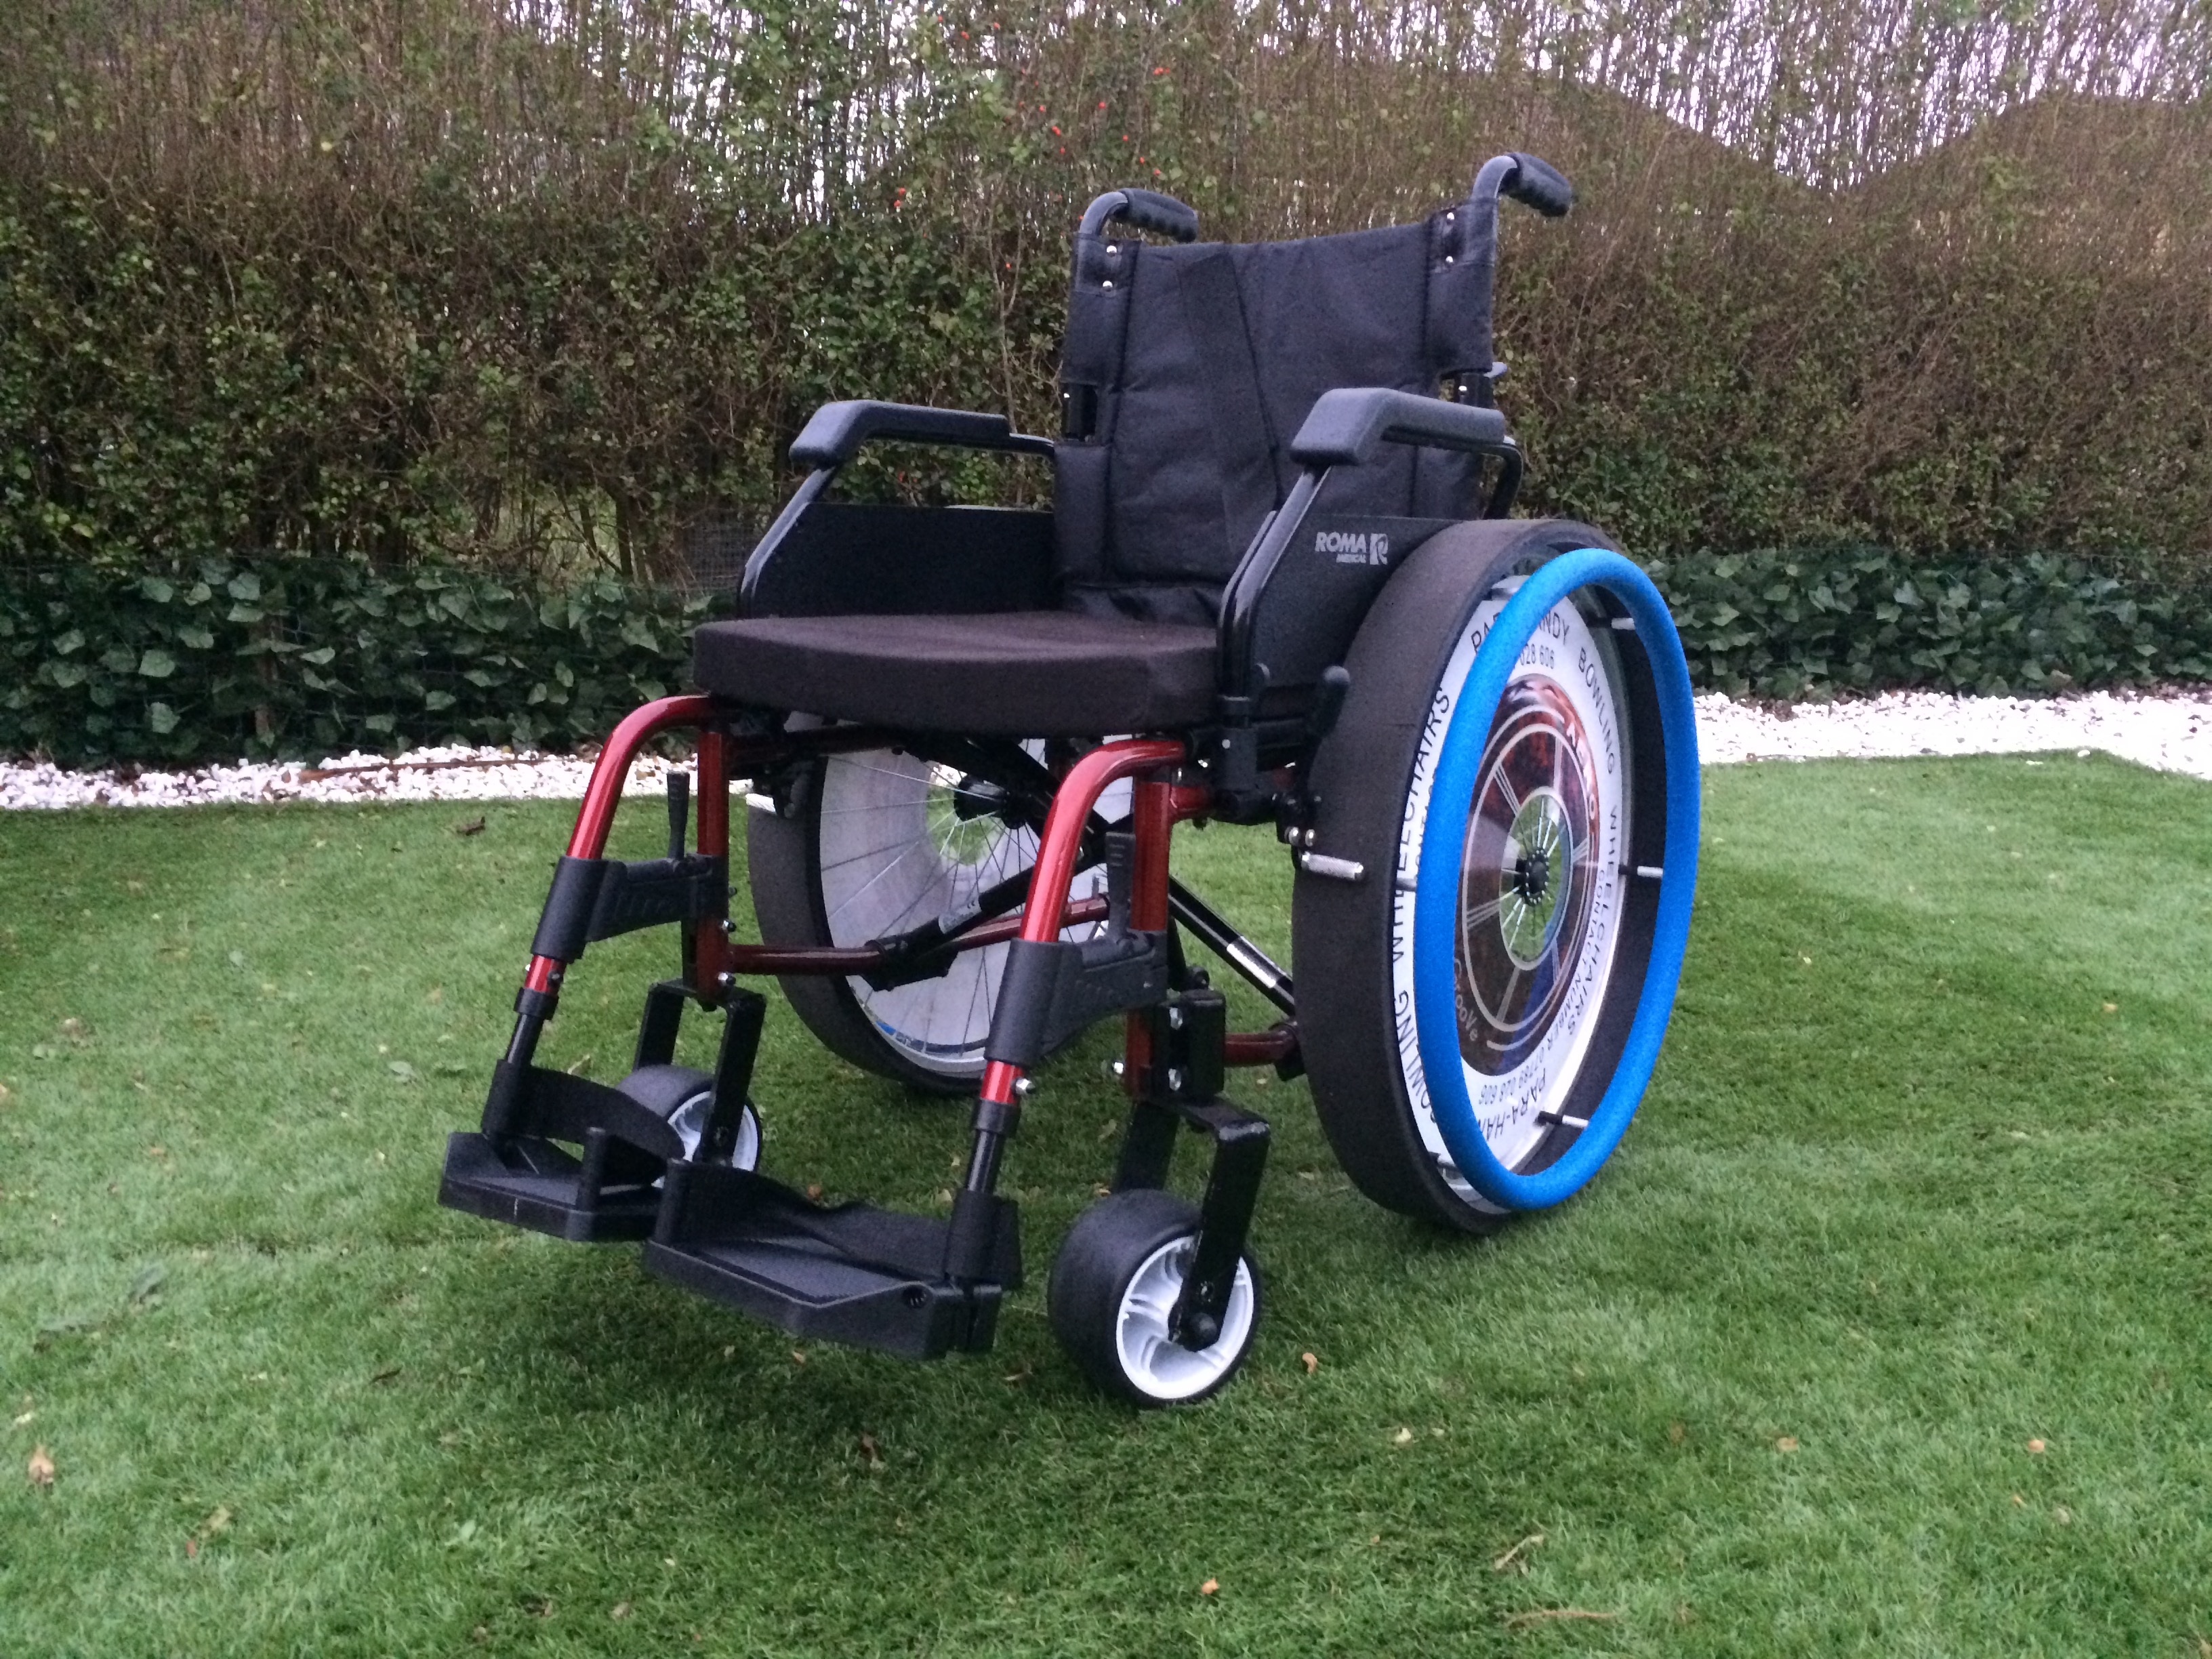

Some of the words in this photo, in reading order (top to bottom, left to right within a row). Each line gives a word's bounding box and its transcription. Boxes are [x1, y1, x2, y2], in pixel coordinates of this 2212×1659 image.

[1315, 531, 1367, 552] ROMA
[1539, 644, 1555, 669] 606
[1578, 647, 1614, 774] BOWLING
[1567, 805, 1617, 1036] WHEELCHAIRS
[1582, 869, 1605, 968] CONTACT
[1547, 972, 1581, 1050] NUMBER
